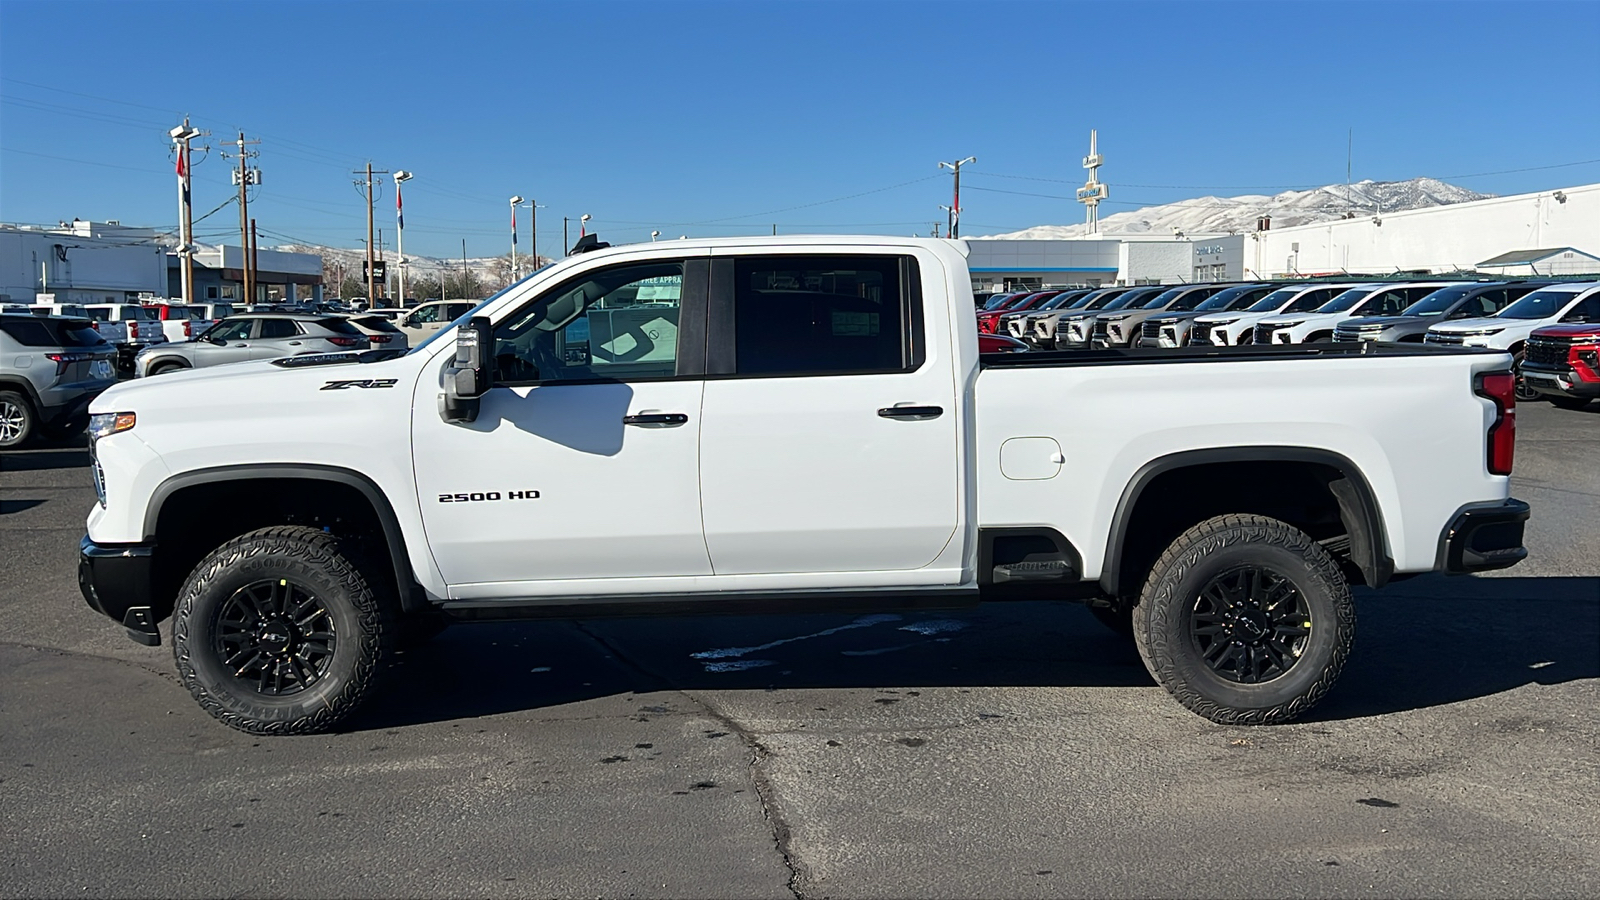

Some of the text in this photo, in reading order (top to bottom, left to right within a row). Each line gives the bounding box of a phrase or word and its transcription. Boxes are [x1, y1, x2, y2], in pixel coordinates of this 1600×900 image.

[319, 379, 399, 390] ZR2
[438, 490, 540, 503] 2500 HD
[238, 557, 342, 599] GOODYEAR
